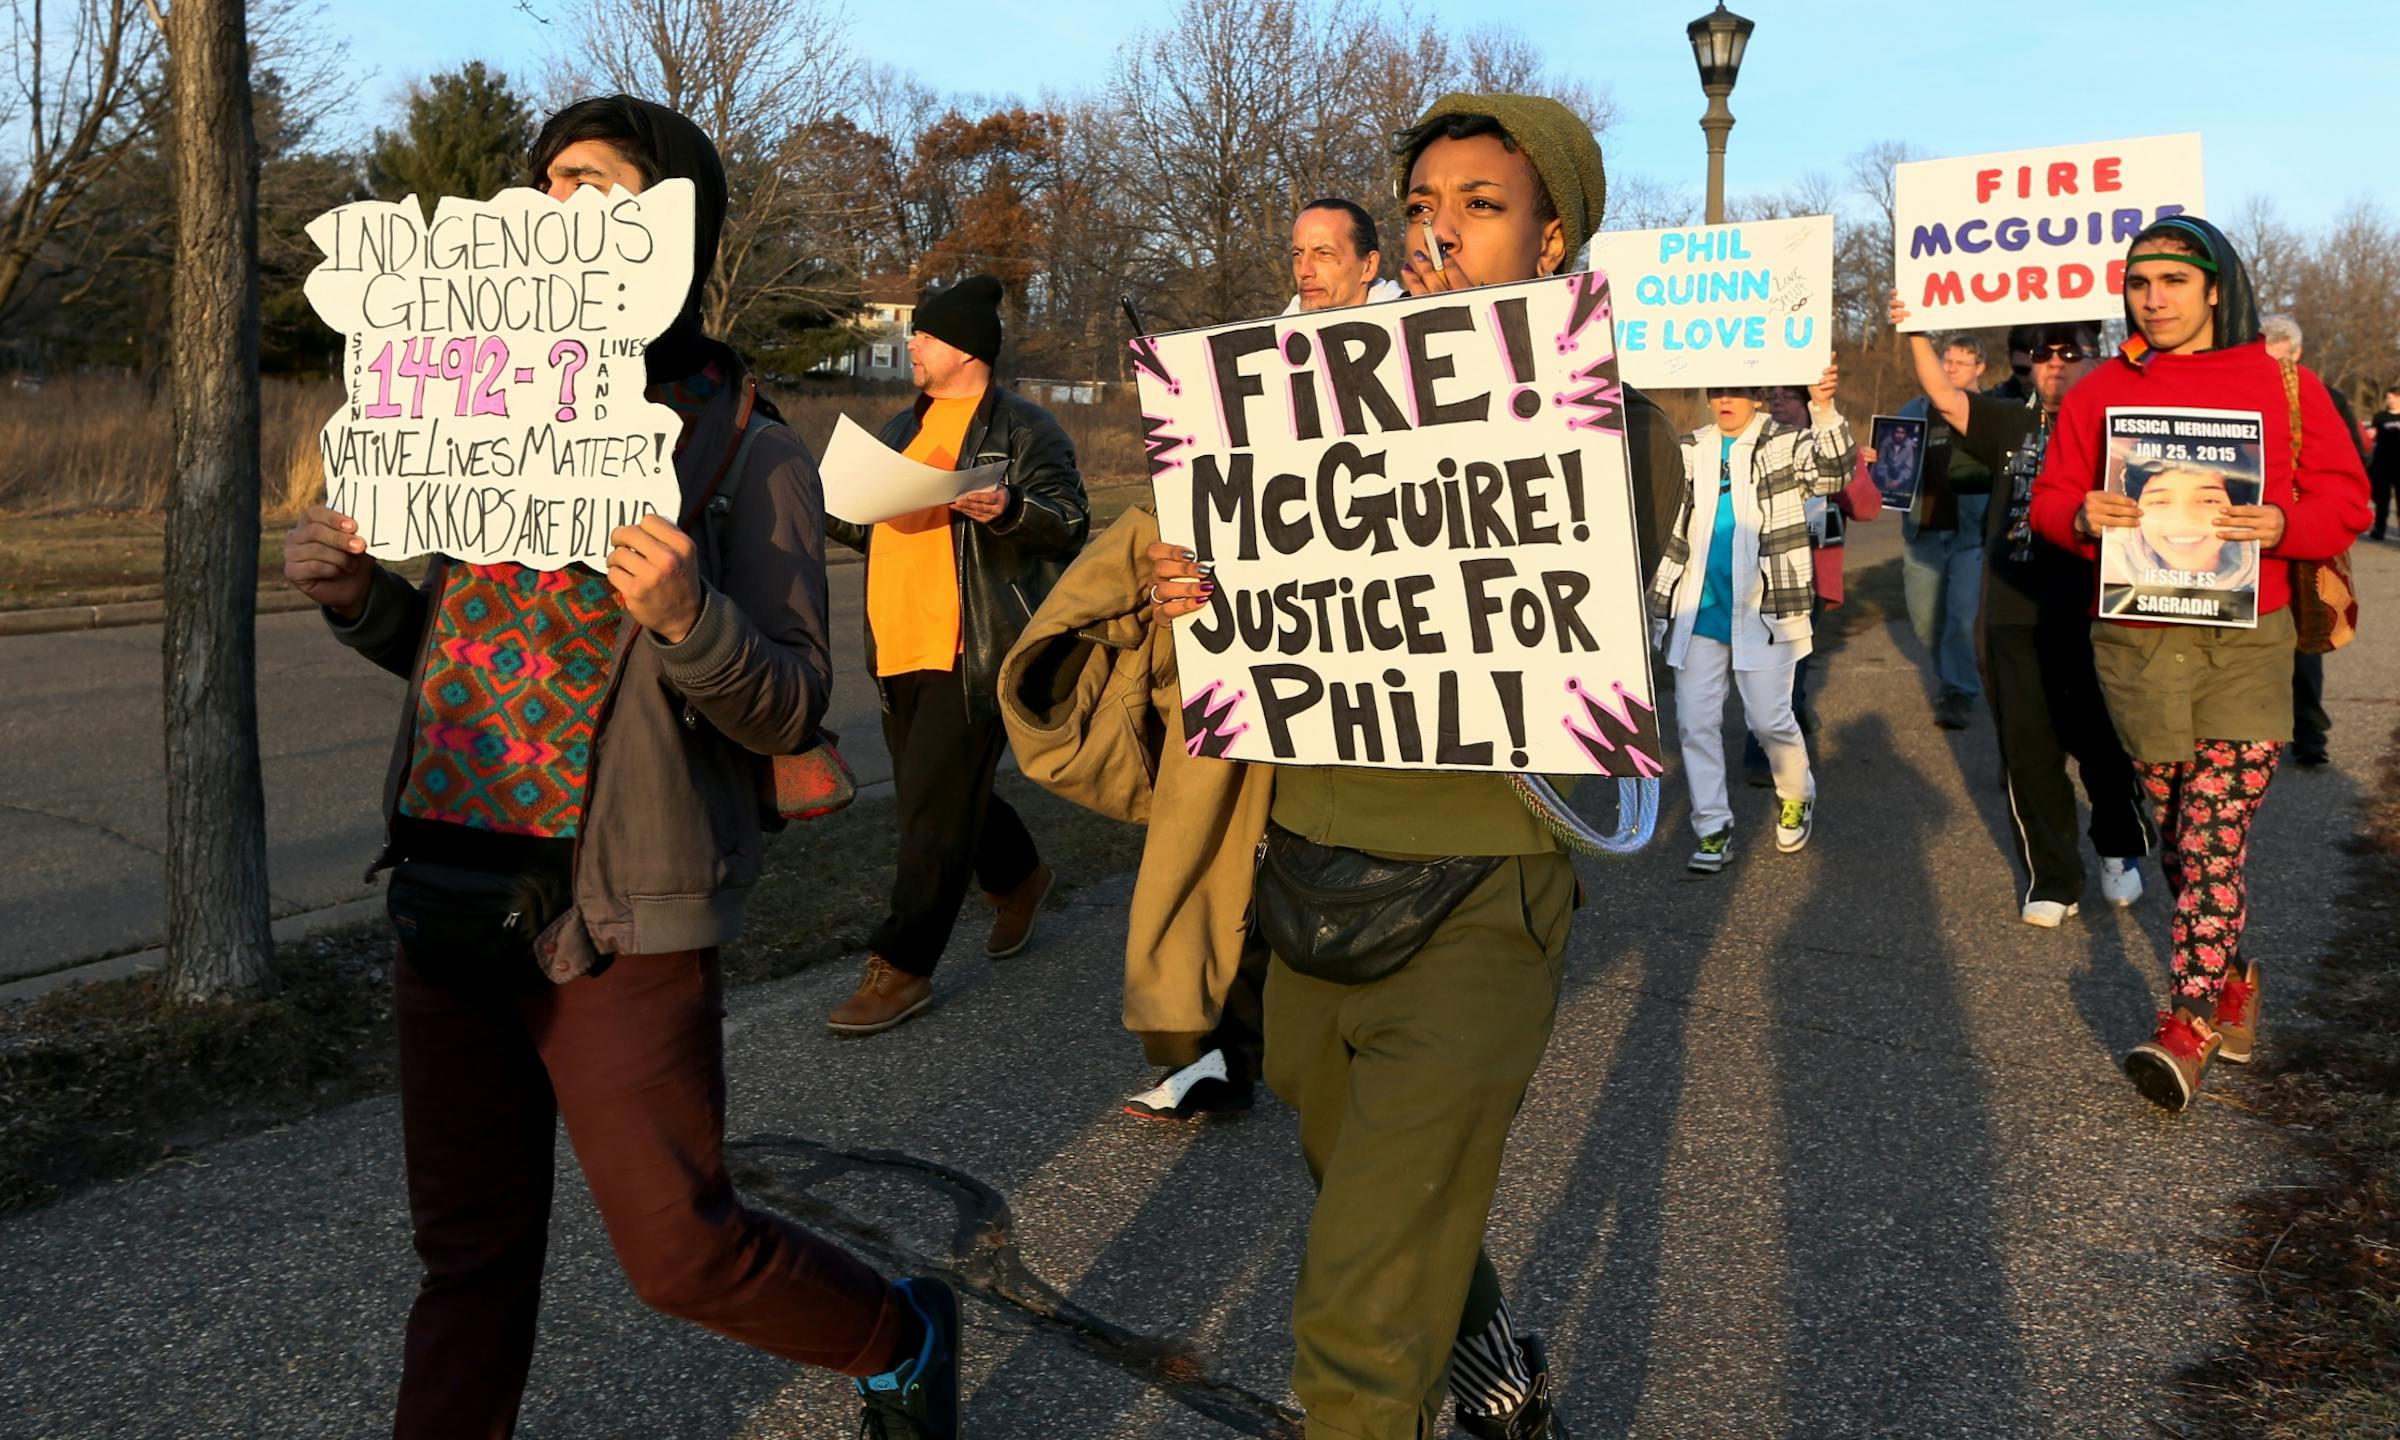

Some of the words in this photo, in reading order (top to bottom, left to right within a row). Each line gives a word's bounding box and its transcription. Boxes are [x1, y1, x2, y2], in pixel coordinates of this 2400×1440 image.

[1976, 157, 2122, 203] FIRE
[1659, 228, 1751, 264] PHIL
[1635, 269, 1770, 306] QUINN
[1922, 259, 2125, 307] MURDE
[363, 271, 626, 333] GENOCIDE:
[600, 337, 648, 357] LIVES
[1662, 316, 1767, 350] LOVE
[1784, 316, 1813, 349] U
[351, 332, 363, 422] STOLEN
[2113, 418, 2171, 435] JESSICA
[2174, 420, 2258, 440] HERNANDEZ
[518, 423, 667, 478] MATTER!
[2135, 442, 2162, 458] JAN
[2196, 445, 2236, 462] 2015
[513, 494, 565, 556] ARE
[2143, 568, 2193, 587] JESSIE
[2197, 571, 2217, 588] ES
[1460, 557, 1600, 654] FOR
[2136, 594, 2220, 617] SAGRADA!
